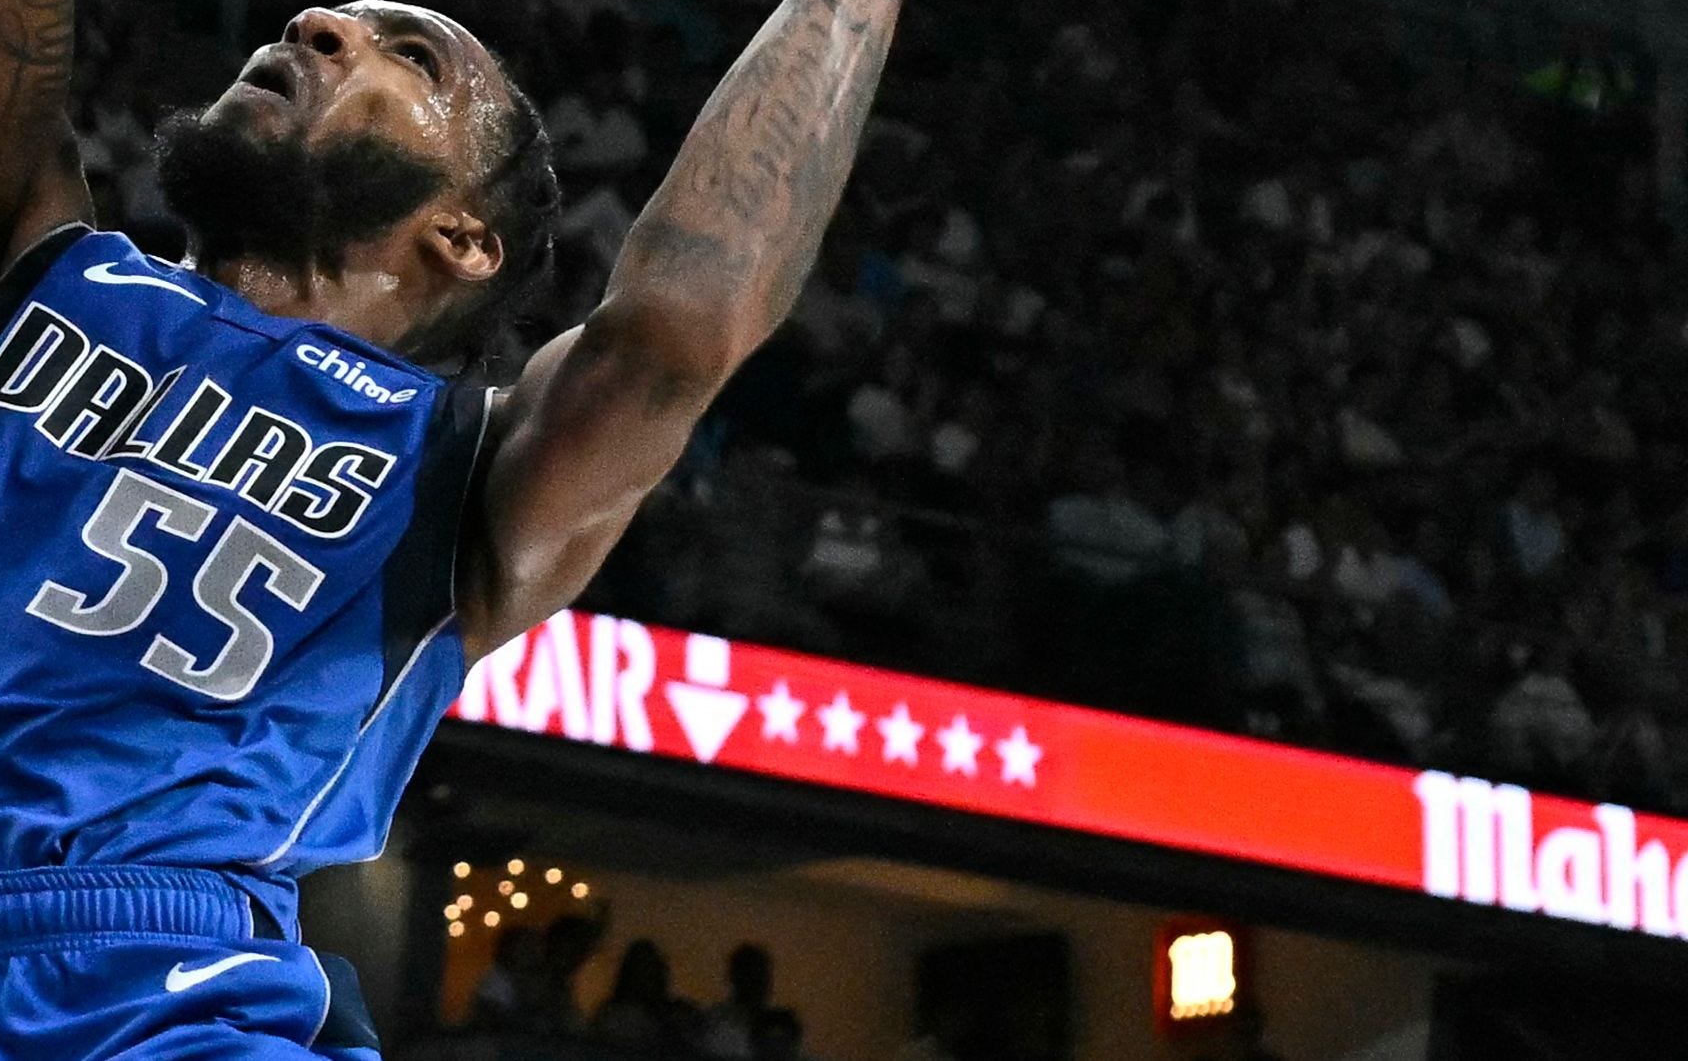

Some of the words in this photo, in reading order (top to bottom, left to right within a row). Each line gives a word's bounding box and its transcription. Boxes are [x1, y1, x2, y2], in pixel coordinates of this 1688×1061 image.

[296, 343, 418, 403] chime
[25, 467, 326, 701] 55
[1414, 769, 1688, 941] Mah
